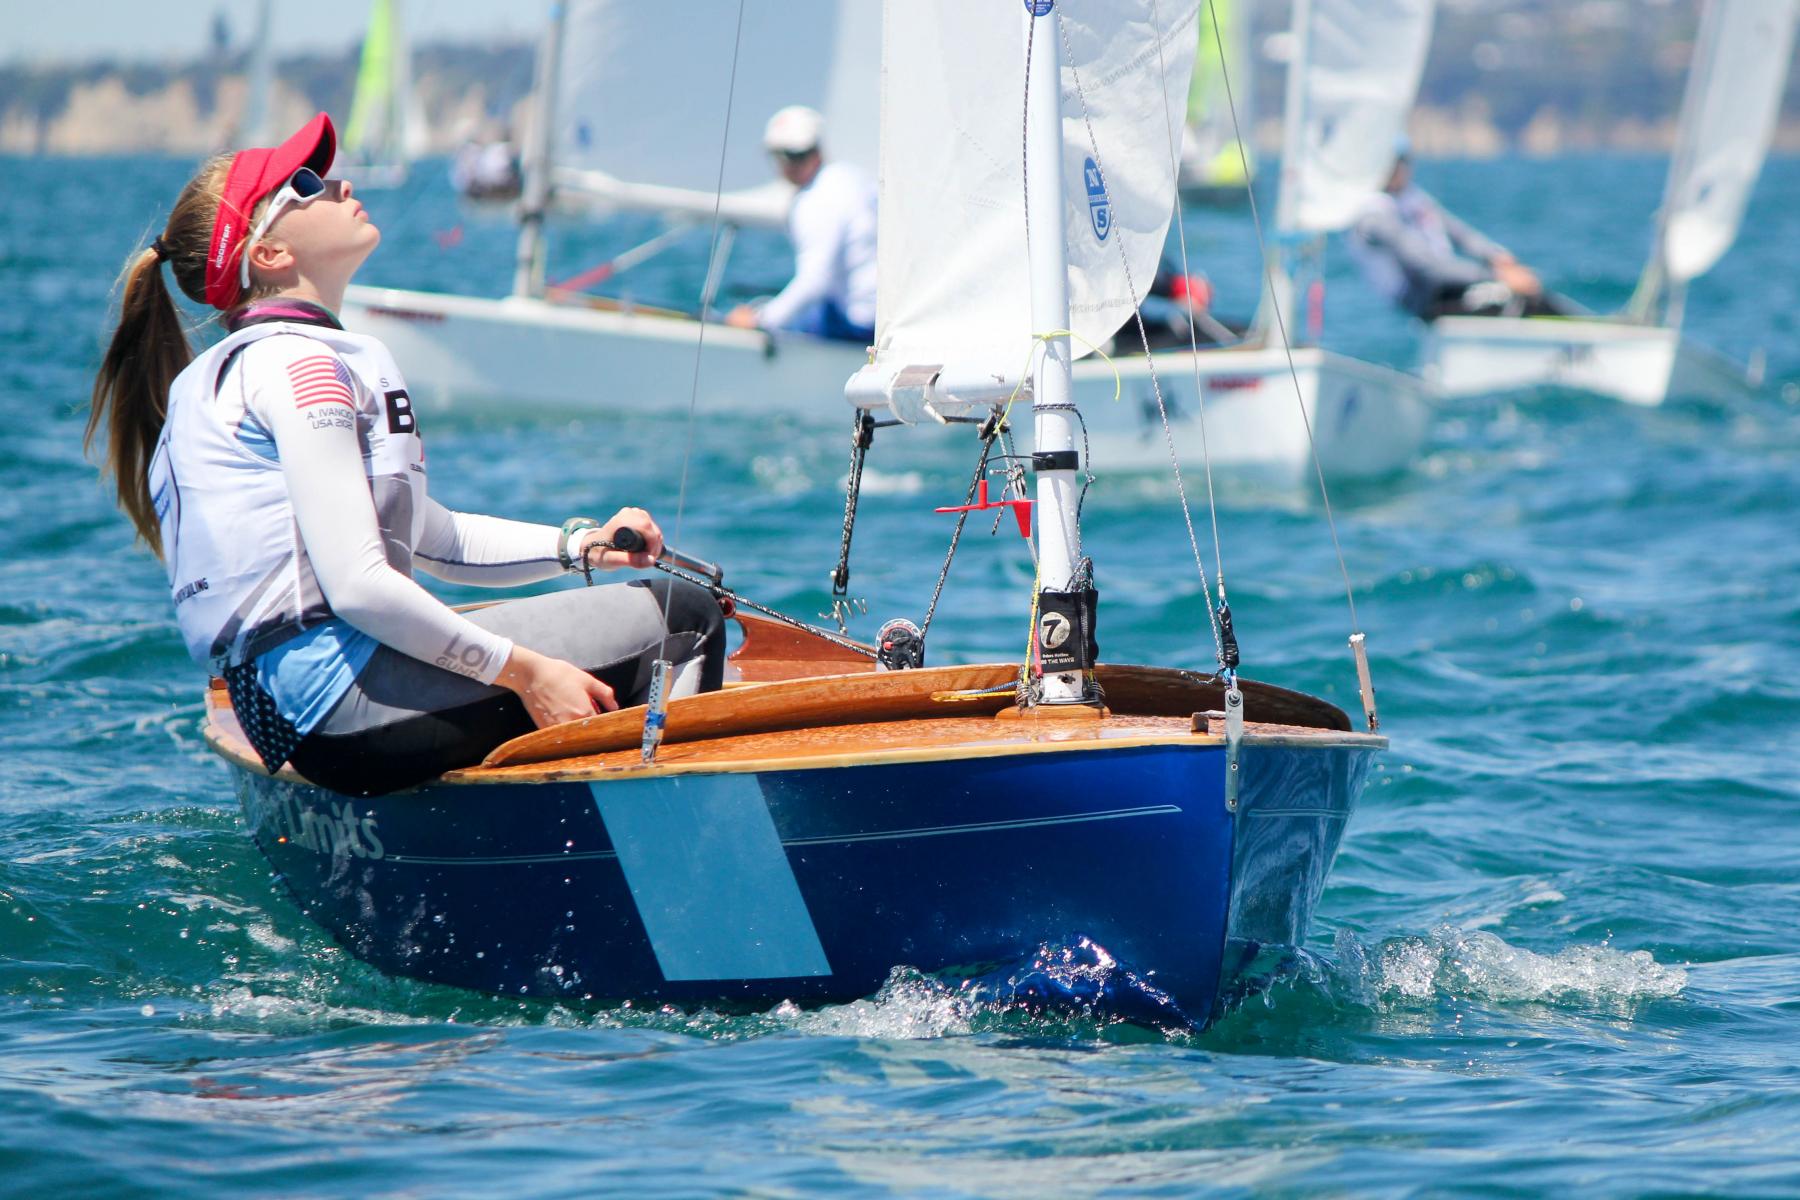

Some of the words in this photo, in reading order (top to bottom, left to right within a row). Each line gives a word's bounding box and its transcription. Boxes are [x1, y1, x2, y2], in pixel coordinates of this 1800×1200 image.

[215, 223, 231, 269] ROOSTER
[312, 419, 334, 430] USA
[384, 389, 418, 436] B
[1043, 619, 1062, 646] 7
